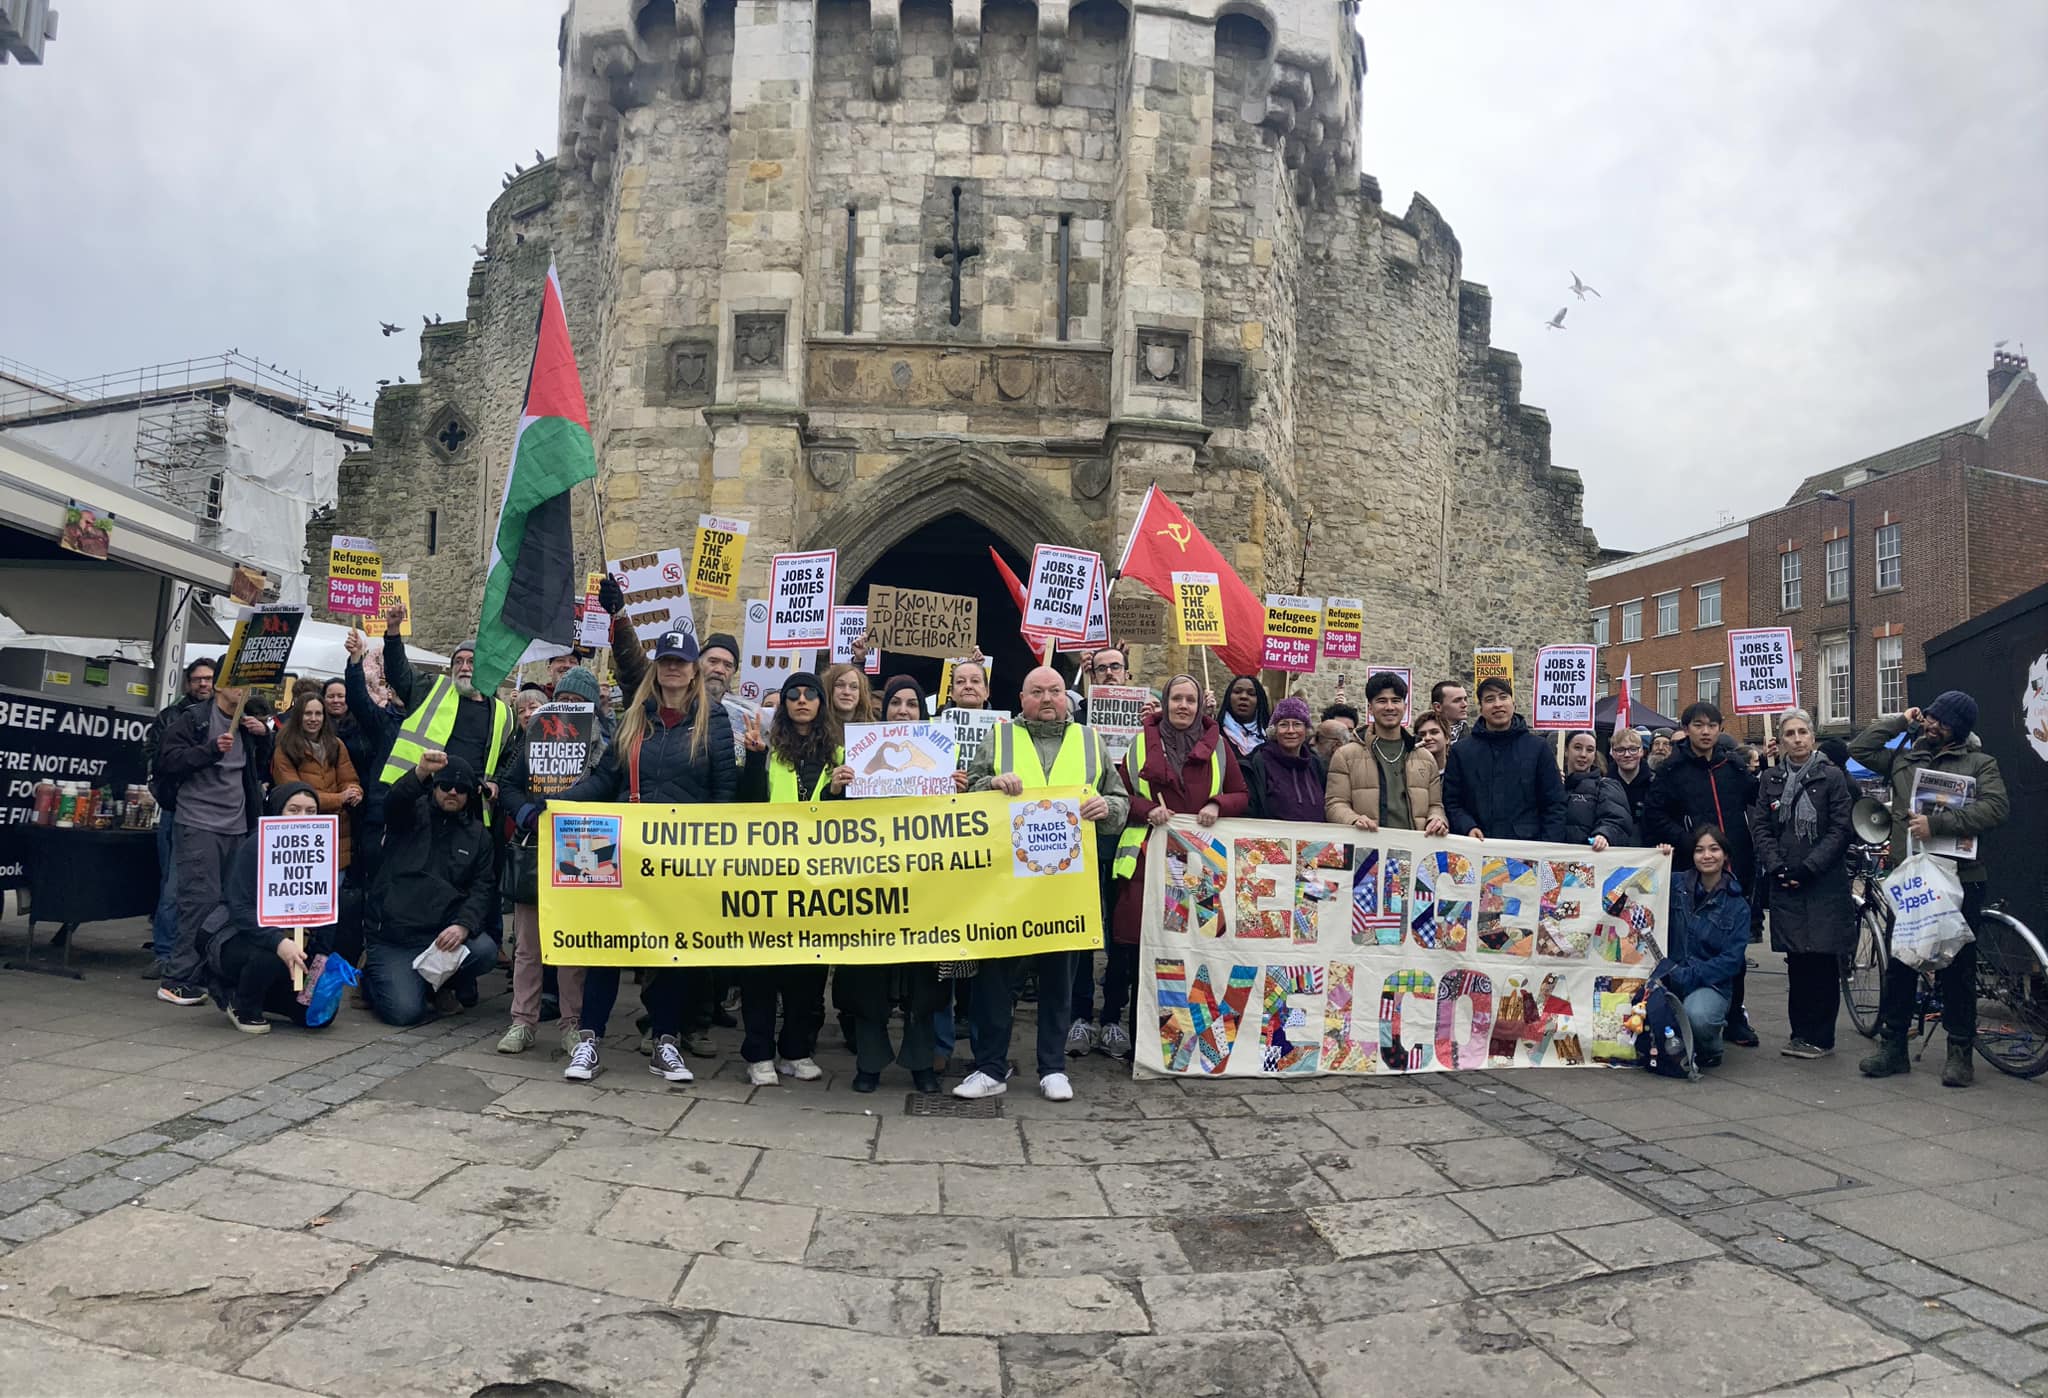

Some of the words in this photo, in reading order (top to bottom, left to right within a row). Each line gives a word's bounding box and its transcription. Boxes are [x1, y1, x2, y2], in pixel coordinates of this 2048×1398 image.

[704, 530, 733, 545] STOP
[703, 543, 723, 557] THE
[333, 551, 380, 565] Refugees
[699, 556, 720, 570] FAR
[333, 565, 377, 577] welcome
[782, 569, 812, 582] JOBS
[815, 568, 824, 579] &
[1042, 560, 1074, 575] JOBS
[1077, 566, 1086, 577] &
[697, 568, 732, 585] RIGHT
[1040, 573, 1085, 590] HOMES
[331, 580, 354, 593] Stop
[357, 583, 374, 593] the
[781, 581, 823, 595] HOMES
[1180, 585, 1210, 596] STOP
[331, 593, 345, 604] far
[348, 594, 373, 608] right
[624, 585, 683, 604] ASCIST
[1047, 587, 1074, 601] NOT
[789, 596, 814, 609] NOT
[877, 593, 890, 608] I
[895, 591, 937, 613] KNOW
[942, 597, 972, 617] WHO
[1033, 598, 1083, 616] RACISM
[1182, 597, 1204, 607] THE
[776, 609, 824, 624] RACISM
[1184, 608, 1204, 619] FAR
[1269, 609, 1317, 623] Refugees
[1328, 609, 1360, 619] Refugees
[841, 617, 864, 626] JOBS
[873, 610, 892, 623] I'D
[895, 611, 949, 629] PREFER
[952, 617, 972, 632] AS
[1185, 620, 1219, 632] RIGHT
[1328, 620, 1359, 629] welcome
[867, 628, 879, 643] A
[1268, 623, 1313, 635] welcome
[245, 636, 292, 650] REFUGEES
[1326, 632, 1344, 642] Stop
[1345, 633, 1357, 642] the
[1266, 638, 1290, 652] Stop
[1293, 640, 1310, 651] the
[1326, 642, 1337, 650] far
[1338, 643, 1356, 653] right
[1740, 642, 1770, 654] JOBS
[1773, 641, 1782, 652] &
[241, 649, 287, 664] WELCOME
[1265, 650, 1281, 661] far
[1283, 651, 1309, 665] right
[1476, 655, 1501, 664] SMASH
[1545, 658, 1574, 669] JOBS
[1577, 658, 1586, 669] &
[1740, 653, 1783, 667] HOMES
[1476, 667, 1507, 676] FASCISM
[1544, 670, 1586, 682] HOMES
[1750, 666, 1775, 679] NOT
[1553, 683, 1577, 694] NOT
[1740, 677, 1788, 691] RACISM
[1092, 698, 1119, 712] FUND
[1541, 695, 1587, 706] RACISM
[58, 709, 109, 738] AND
[1091, 712, 1144, 726] SERVICES
[847, 732, 878, 760] SPREAD
[883, 726, 909, 738] LOVE
[913, 725, 930, 737] NOT
[929, 730, 955, 754] HATE
[529, 742, 586, 758] REFUGEES
[33, 754, 68, 773] NOT
[69, 757, 107, 776] FAST
[529, 758, 584, 775] WELCOME
[850, 785, 878, 796] UNITE
[880, 784, 919, 796] AGAINST
[921, 784, 957, 796] RACISM
[642, 821, 738, 846] UNITED
[747, 821, 799, 846] FOR
[807, 819, 886, 847] JOBS,
[893, 810, 989, 842] HOMES
[1027, 821, 1066, 832] TRADES
[272, 834, 309, 849] JOBS
[314, 834, 324, 847] &
[1028, 832, 1067, 843] UNION
[1029, 842, 1068, 852] COUNCILS
[271, 849, 325, 865] HOMES
[640, 859, 655, 877] &
[661, 858, 717, 877] FULLY
[723, 858, 800, 877] FUNDED
[806, 854, 900, 877] SERVICES
[906, 852, 944, 873] FOR
[950, 848, 992, 871] ALL!
[283, 865, 313, 881] NOT
[268, 881, 327, 897] RACISM
[1163, 828, 1657, 963] REFUGEES
[721, 890, 778, 918] NOT
[787, 887, 909, 918] RACISM!
[553, 931, 669, 952] Southampton
[675, 932, 689, 950] &
[692, 931, 743, 949] South
[748, 930, 794, 948] West
[799, 928, 896, 951] Hampshire
[899, 926, 961, 946] Trades
[966, 921, 1018, 943] Union
[1022, 915, 1086, 939] Council
[1155, 958, 1652, 1075] WELCOME
